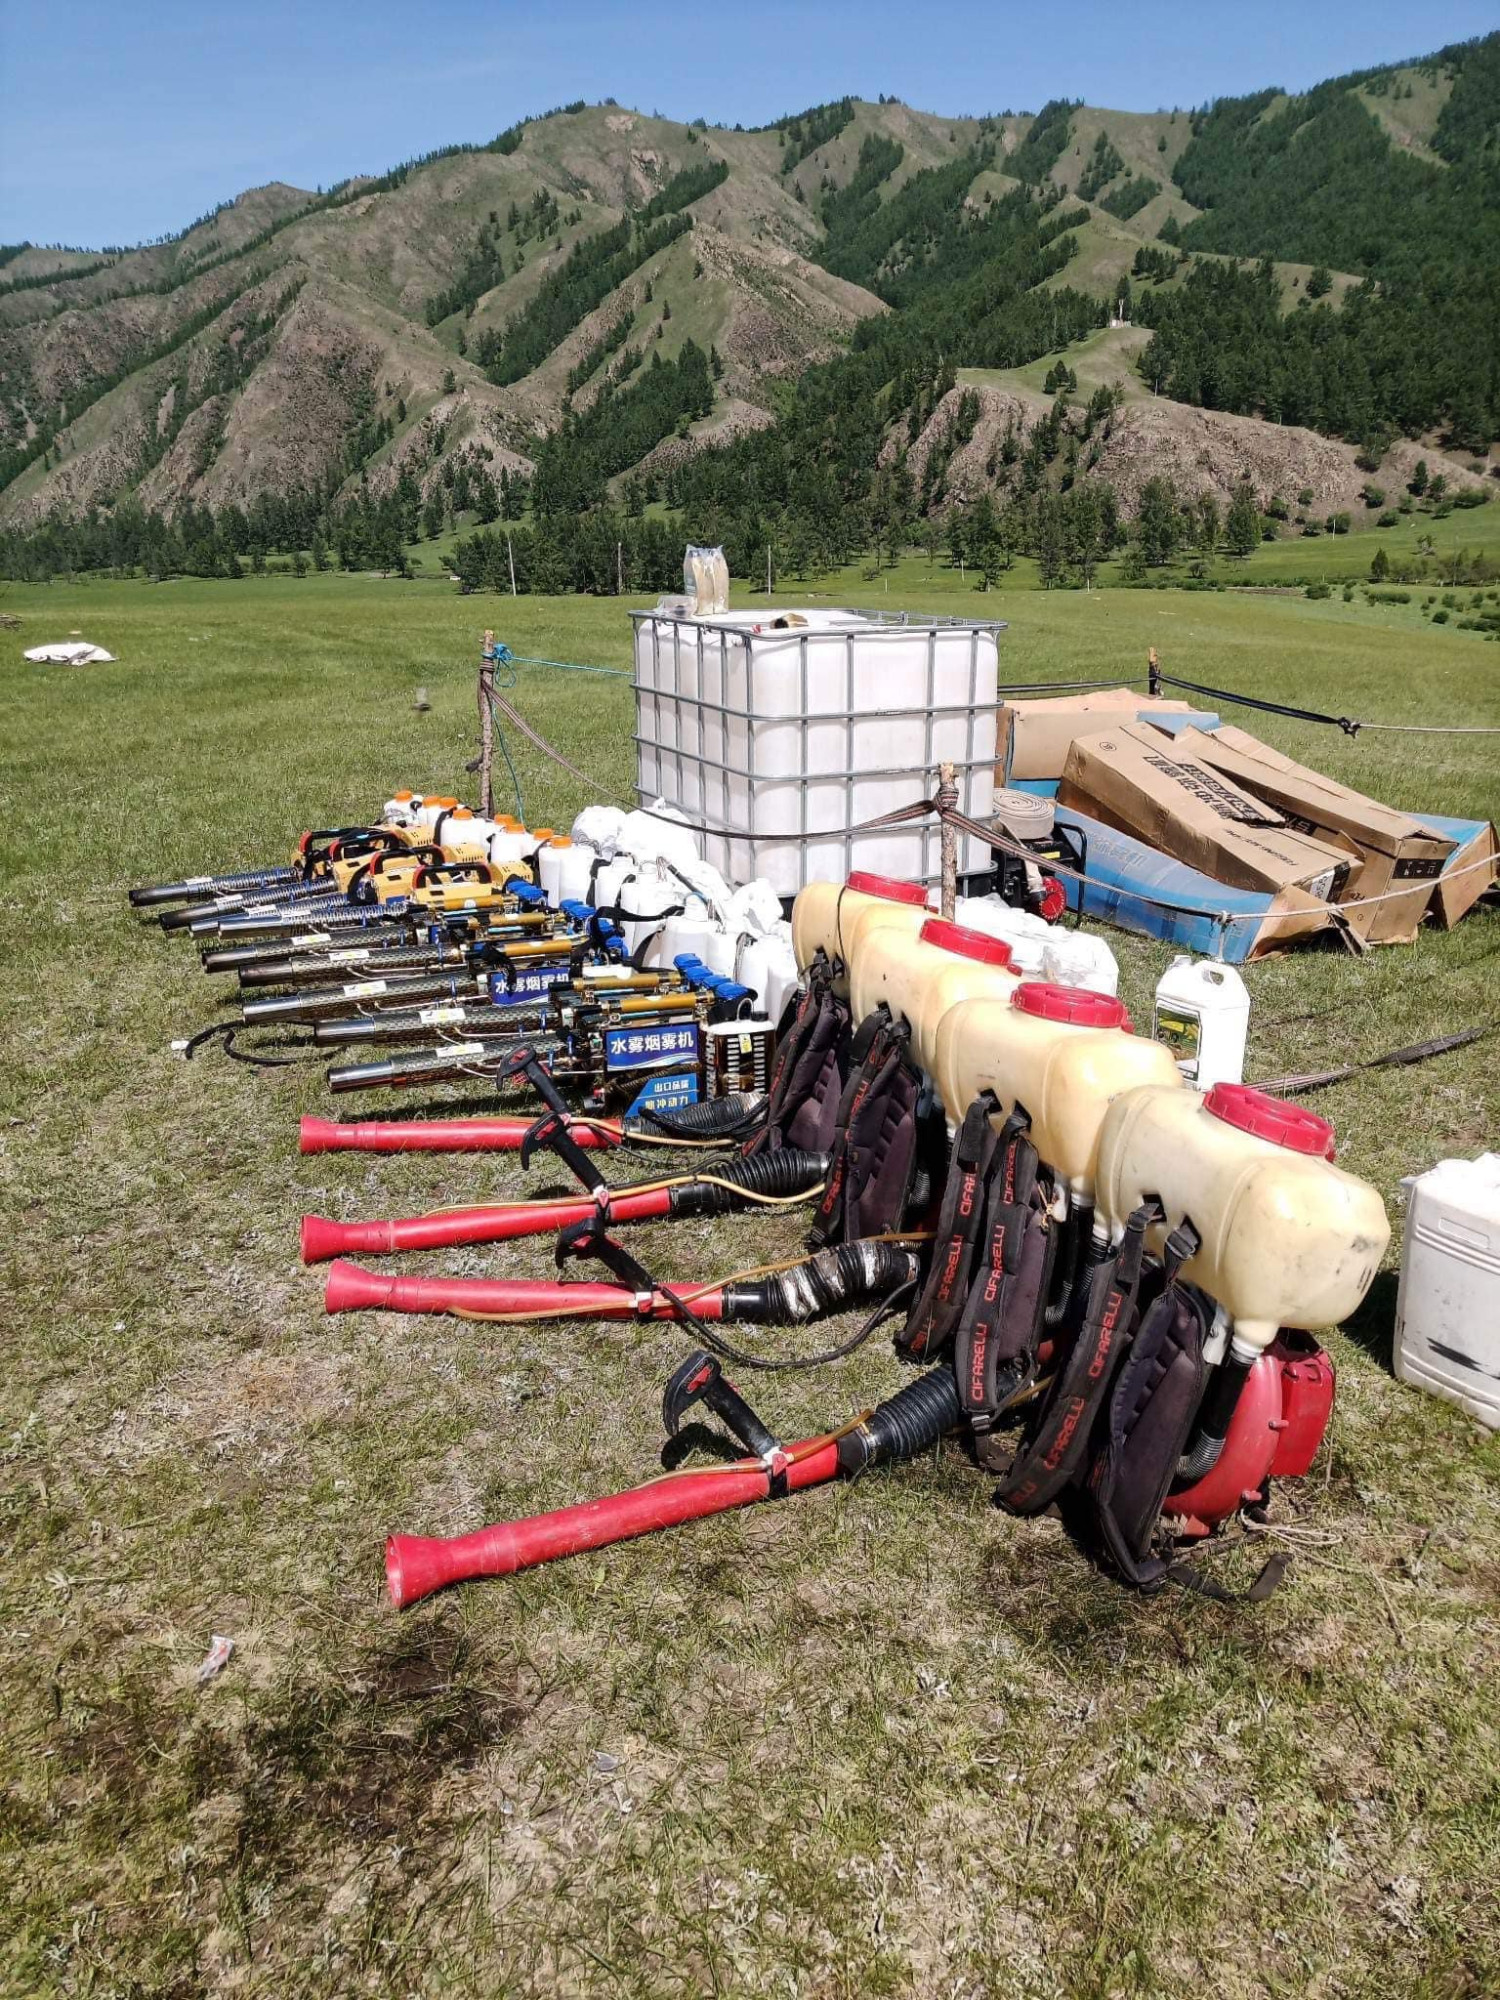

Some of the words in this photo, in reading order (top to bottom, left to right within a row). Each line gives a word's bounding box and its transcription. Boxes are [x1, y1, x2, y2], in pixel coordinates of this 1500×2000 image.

[611, 1031, 694, 1055] 水雾烟雾机
[938, 1235, 964, 1303] CIFARELLI
[984, 1224, 1005, 1302] CIFARELLI
[972, 1322, 988, 1402] CIFARELLI
[1088, 1291, 1123, 1378] CIFARELLI
[1043, 1396, 1085, 1471] CIFARELLI
